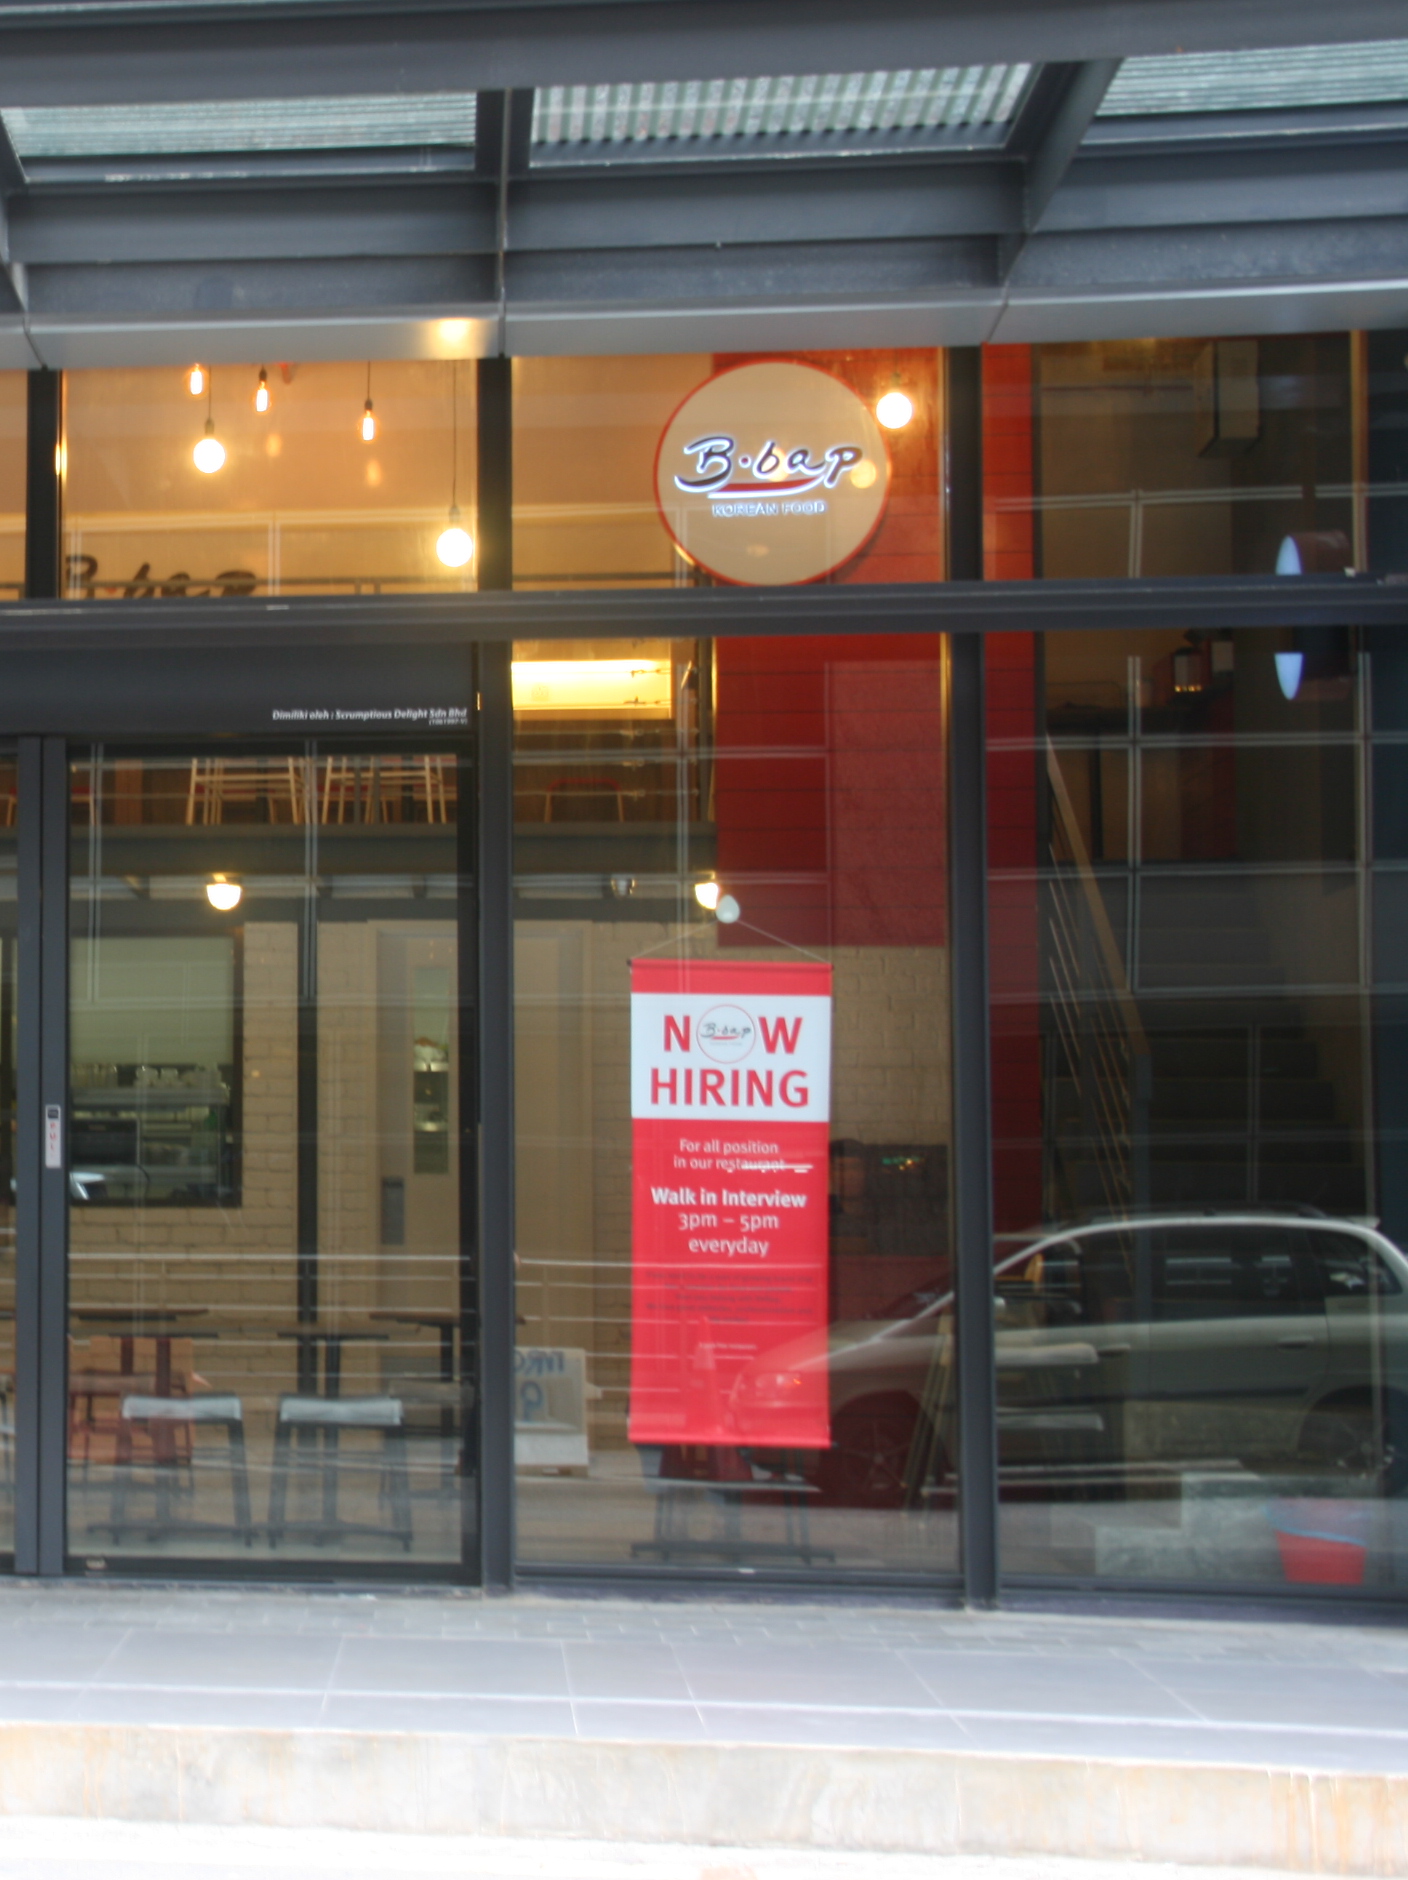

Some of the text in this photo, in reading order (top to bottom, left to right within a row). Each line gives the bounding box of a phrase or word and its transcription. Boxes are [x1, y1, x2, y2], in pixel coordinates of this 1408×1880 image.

[712, 500, 826, 517] KOREAN FOOD
[272, 709, 308, 721] Dimiliki
[335, 708, 392, 721] Scrumptious
[394, 708, 428, 721] Delight
[429, 707, 447, 718] Sdn
[449, 707, 468, 718] Bhd
[651, 1068, 809, 1108] HIRING
[679, 1138, 779, 1156] For all position
[673, 1155, 686, 1168] in
[689, 1158, 713, 1169] our
[650, 1187, 807, 1208] Walk in Interview
[678, 1213, 718, 1231] 3pm
[740, 1214, 780, 1232] 5pm
[688, 1236, 769, 1258] everyday
